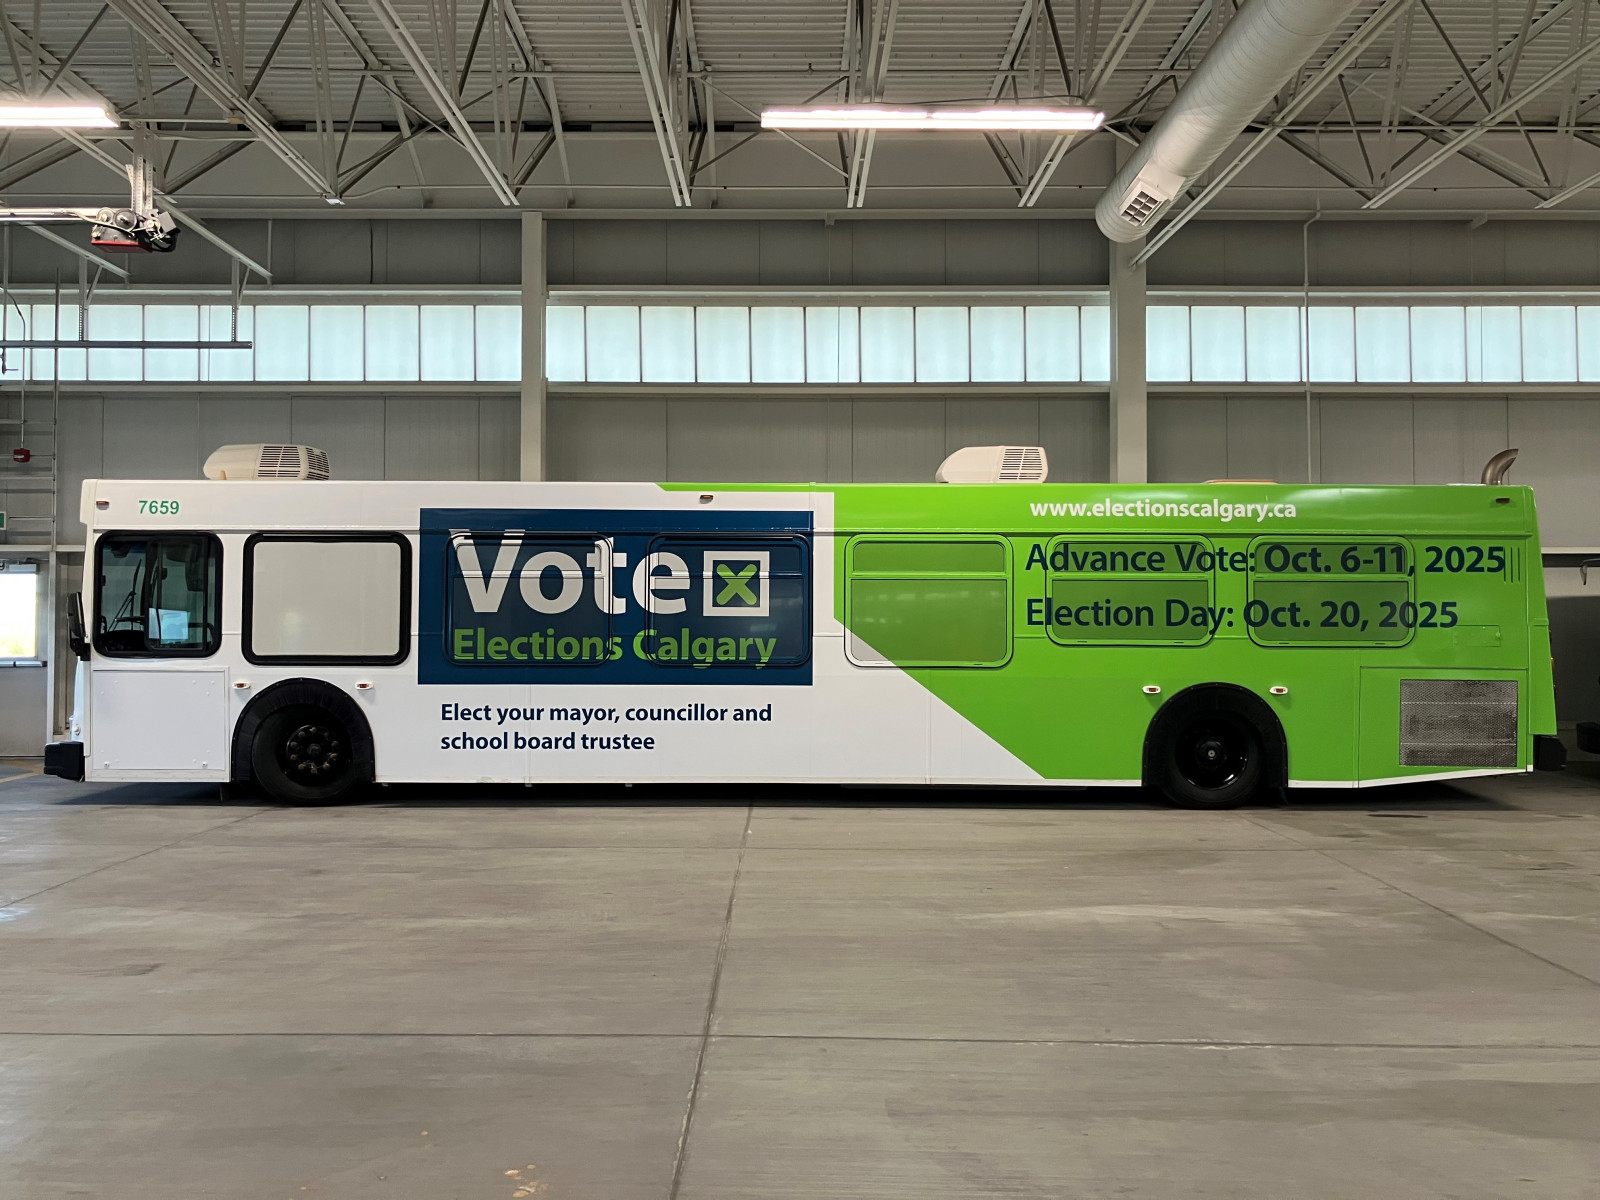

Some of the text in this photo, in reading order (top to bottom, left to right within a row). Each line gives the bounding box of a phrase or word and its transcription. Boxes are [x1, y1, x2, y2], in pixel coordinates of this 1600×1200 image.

[138, 499, 180, 515] 7659
[1030, 499, 1297, 522] www.electionscalgary.ca
[449, 529, 691, 614] Vote
[1025, 543, 1505, 577] Advance Vote: Oct. 6-11, 2025
[1026, 598, 1458, 635] Election Day: Oct. 20, 2025
[453, 627, 777, 669] Elections Calgary
[441, 704, 772, 725] Elect your mayor, councillor and
[440, 732, 655, 750] school board trustee
